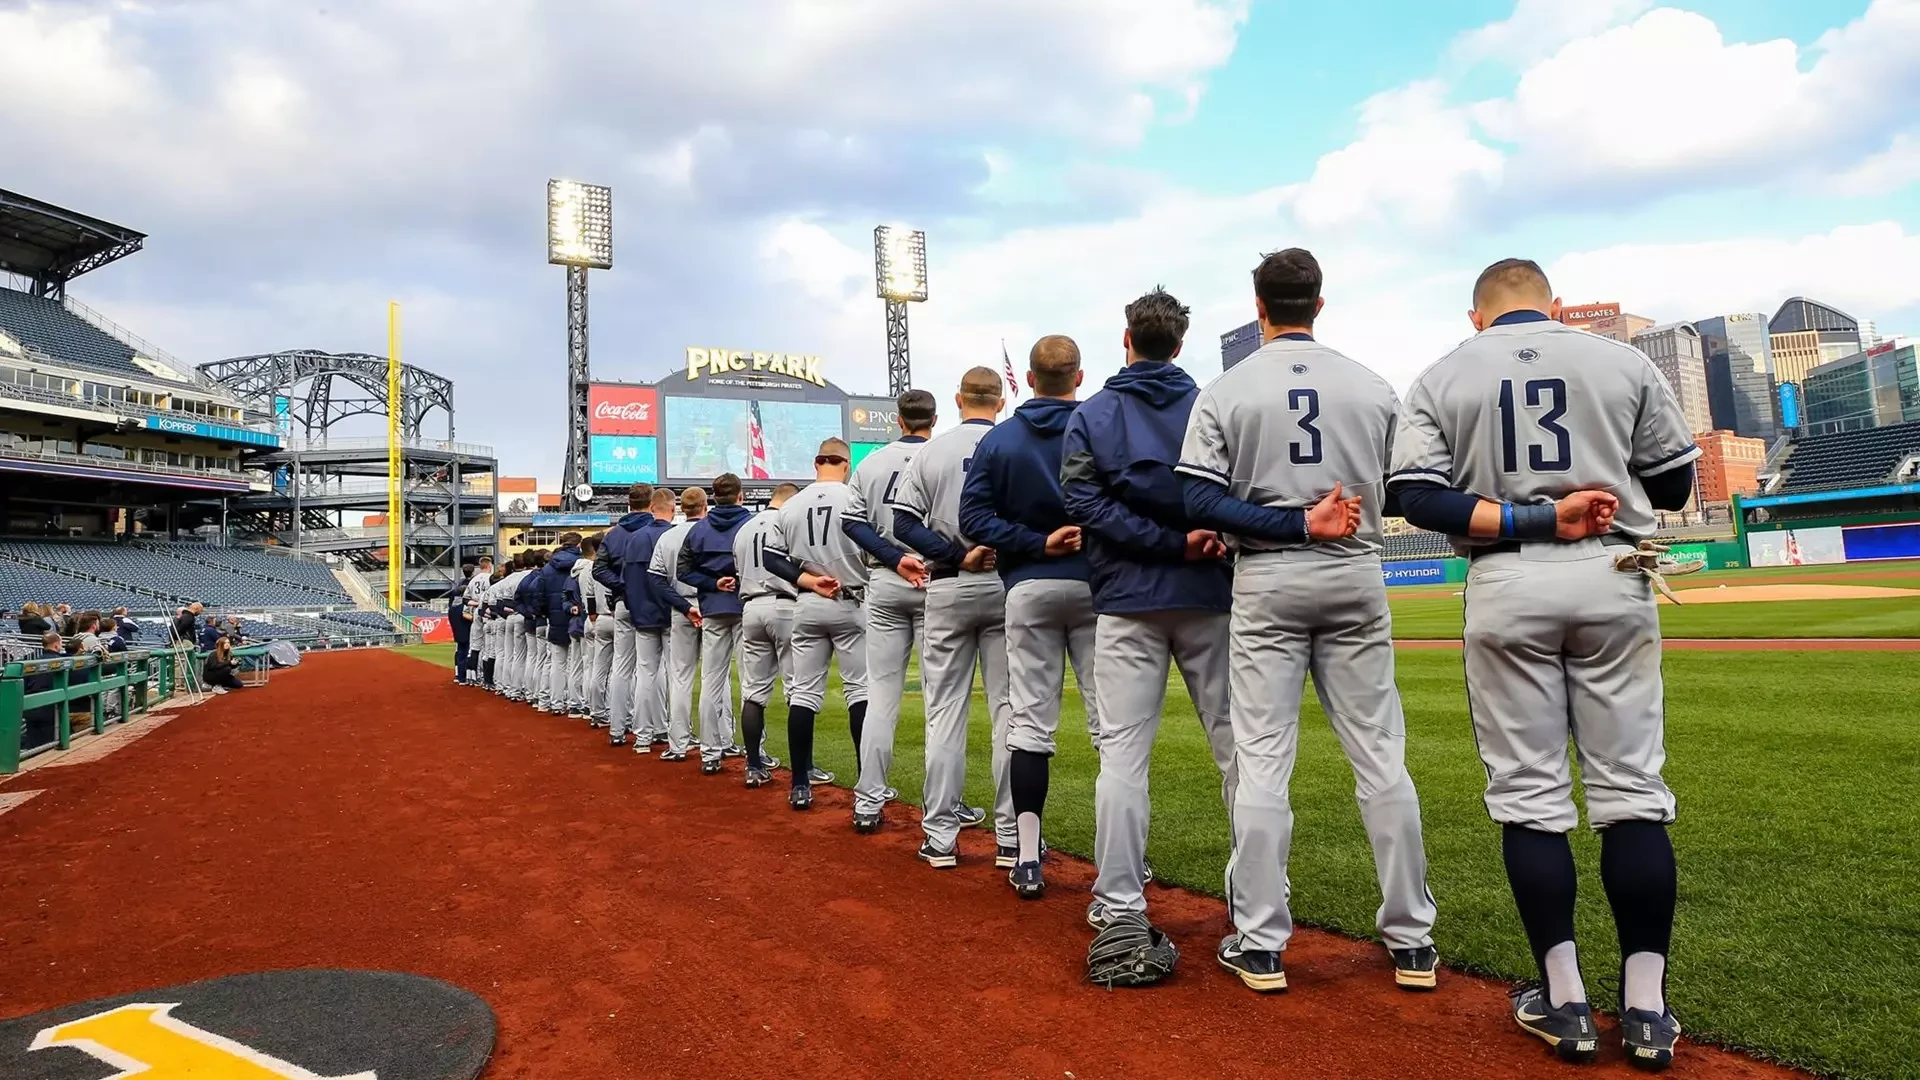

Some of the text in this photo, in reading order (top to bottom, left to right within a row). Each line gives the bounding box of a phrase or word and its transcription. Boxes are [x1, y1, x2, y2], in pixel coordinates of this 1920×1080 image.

[1569, 308, 1615, 320] K&L GATES
[687, 347, 826, 388] PNC PARK
[708, 378, 725, 386] HOME
[747, 380, 780, 389] PITTSBURGH
[595, 401, 651, 420] Coca-Cola
[868, 410, 898, 424] PNC
[159, 418, 197, 433] KOPPERS
[1287, 388, 1323, 465] 3
[1498, 377, 1572, 474] 13
[807, 505, 833, 546] 17
[1395, 568, 1440, 578] HYUNDAI
[474, 581, 487, 595] 34
[1576, 1040, 1596, 1052] NIKE
[1635, 1046, 1659, 1059] NIKE
